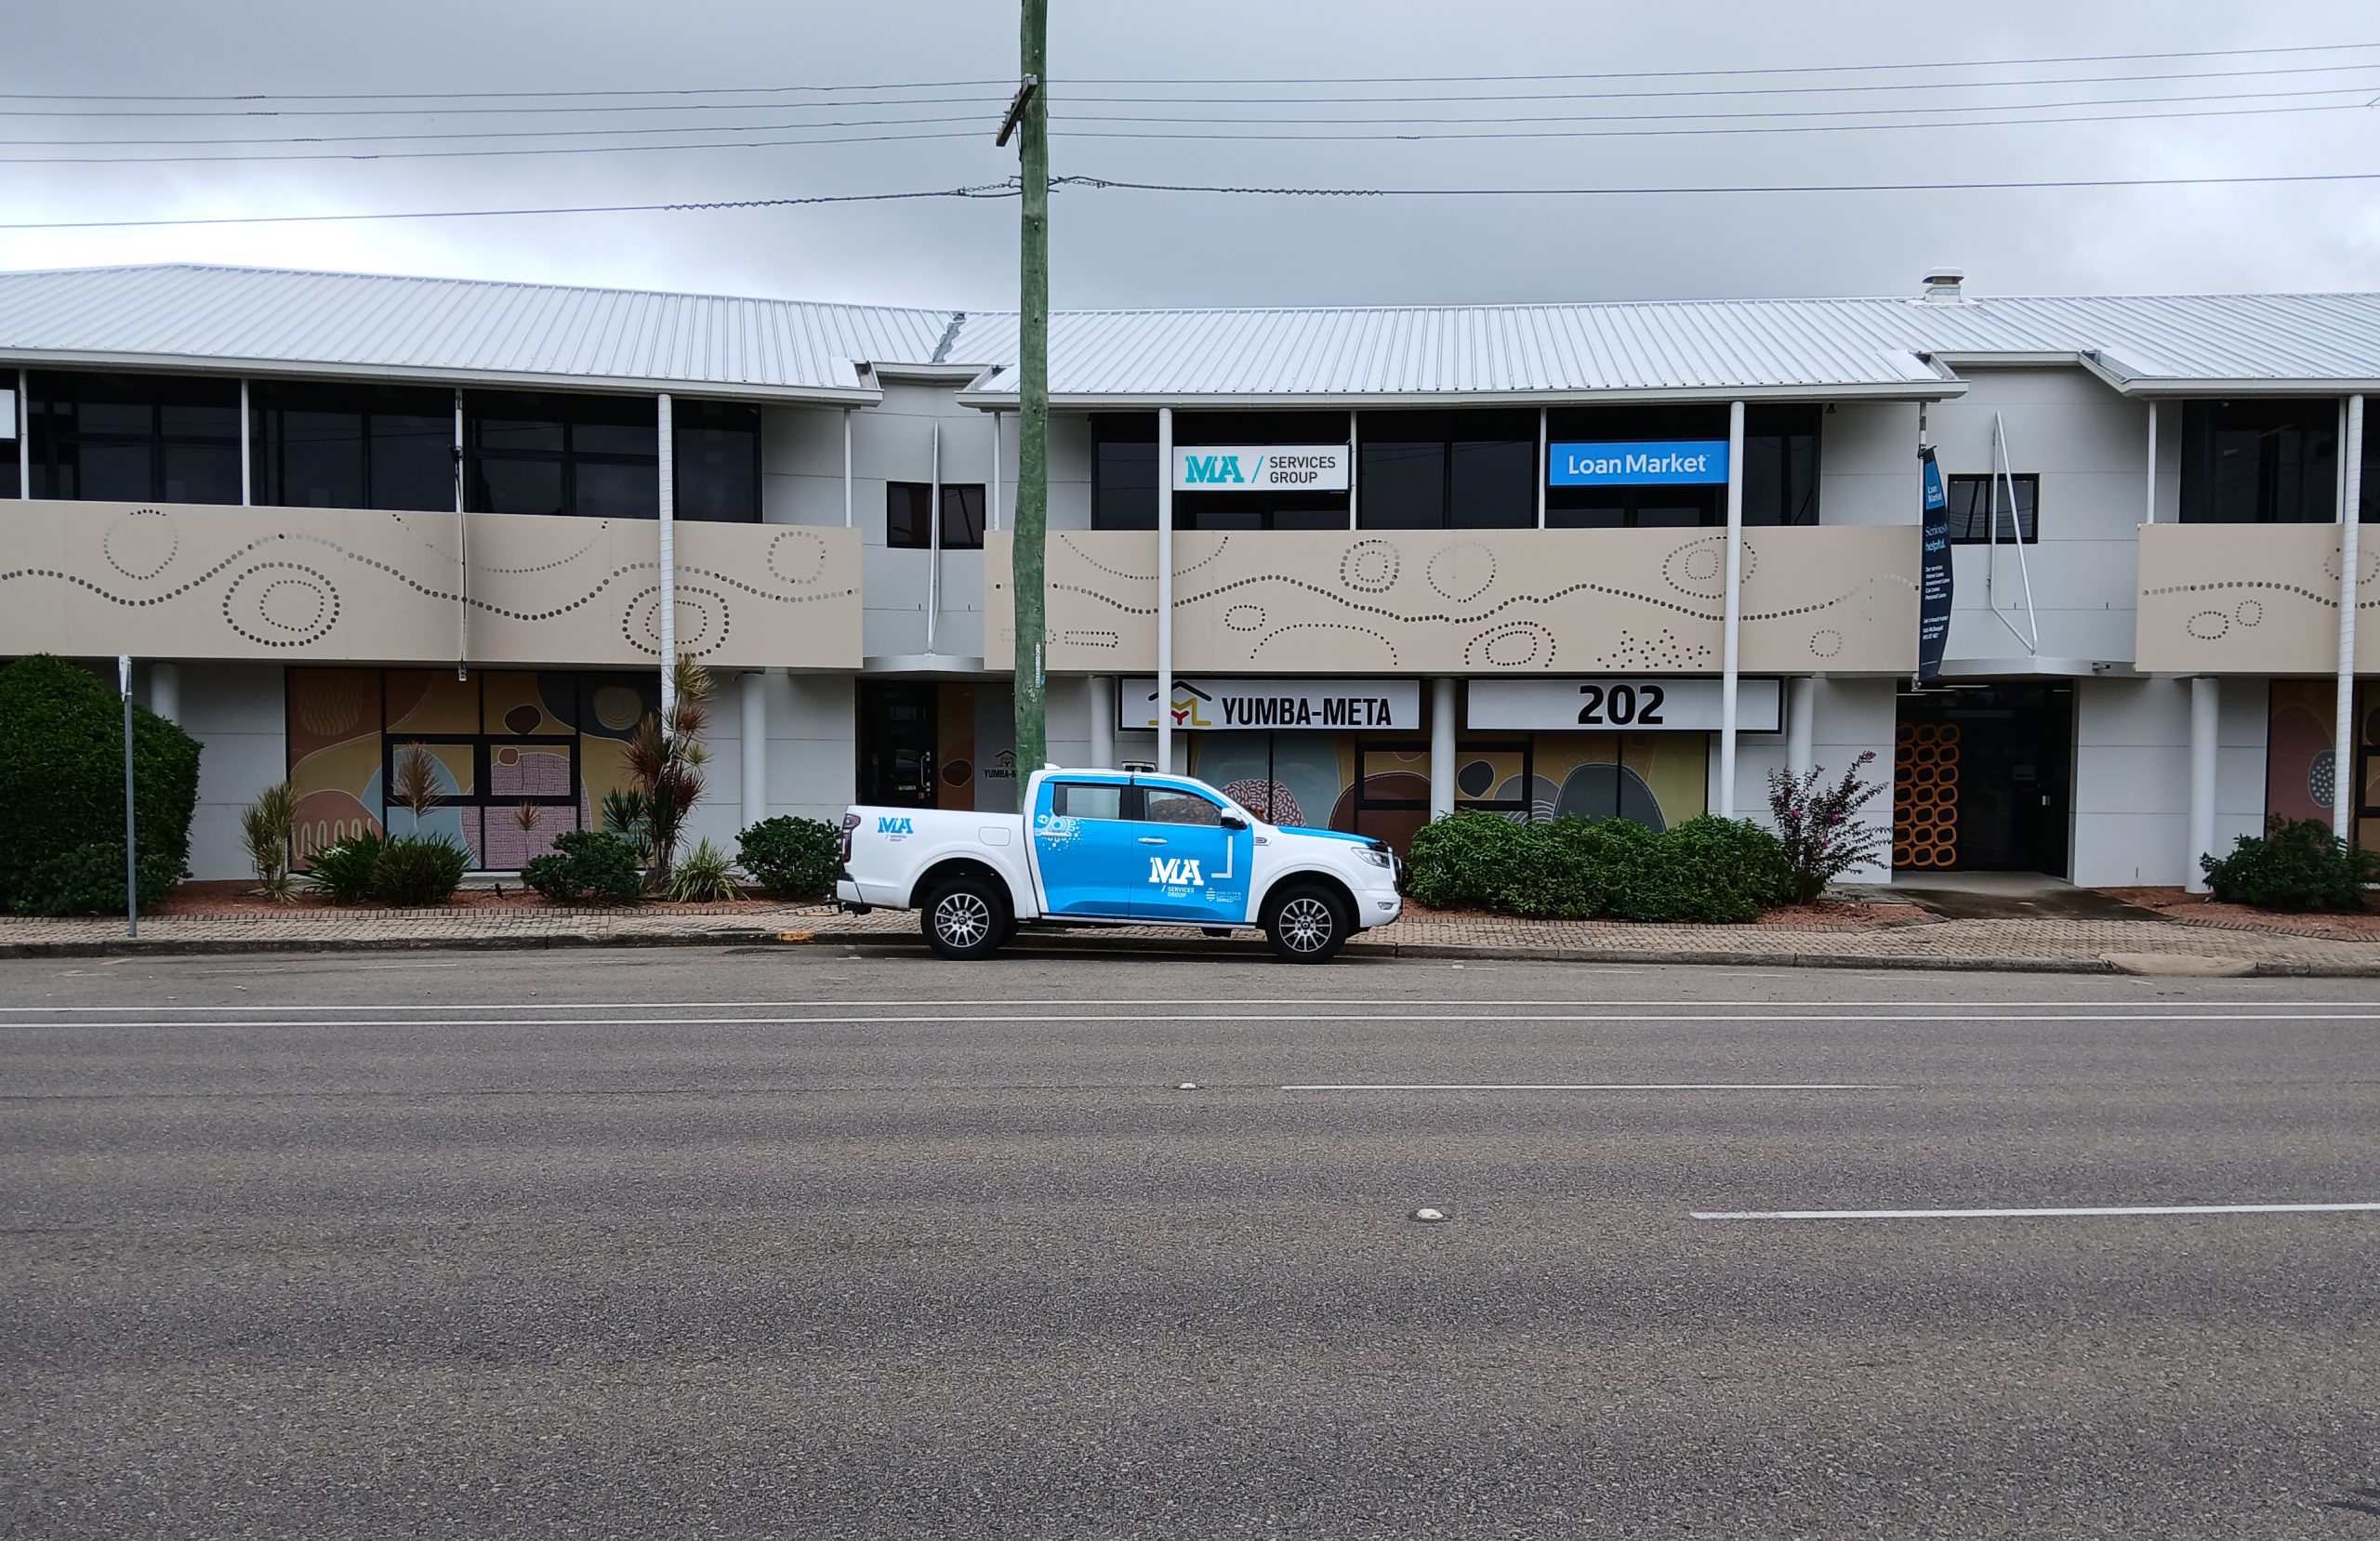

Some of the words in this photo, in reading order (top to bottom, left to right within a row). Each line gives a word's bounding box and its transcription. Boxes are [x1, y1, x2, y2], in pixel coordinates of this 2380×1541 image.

[1185, 455, 1244, 483] MA
[1269, 456, 1336, 468] SERVICES
[1269, 471, 1318, 483] GROUP
[1221, 697, 1393, 726] YUMBA-META
[1577, 684, 1665, 725] 202
[984, 769, 1017, 779] YUMBA-M
[877, 817, 914, 834] MA
[1148, 856, 1205, 886] MA
